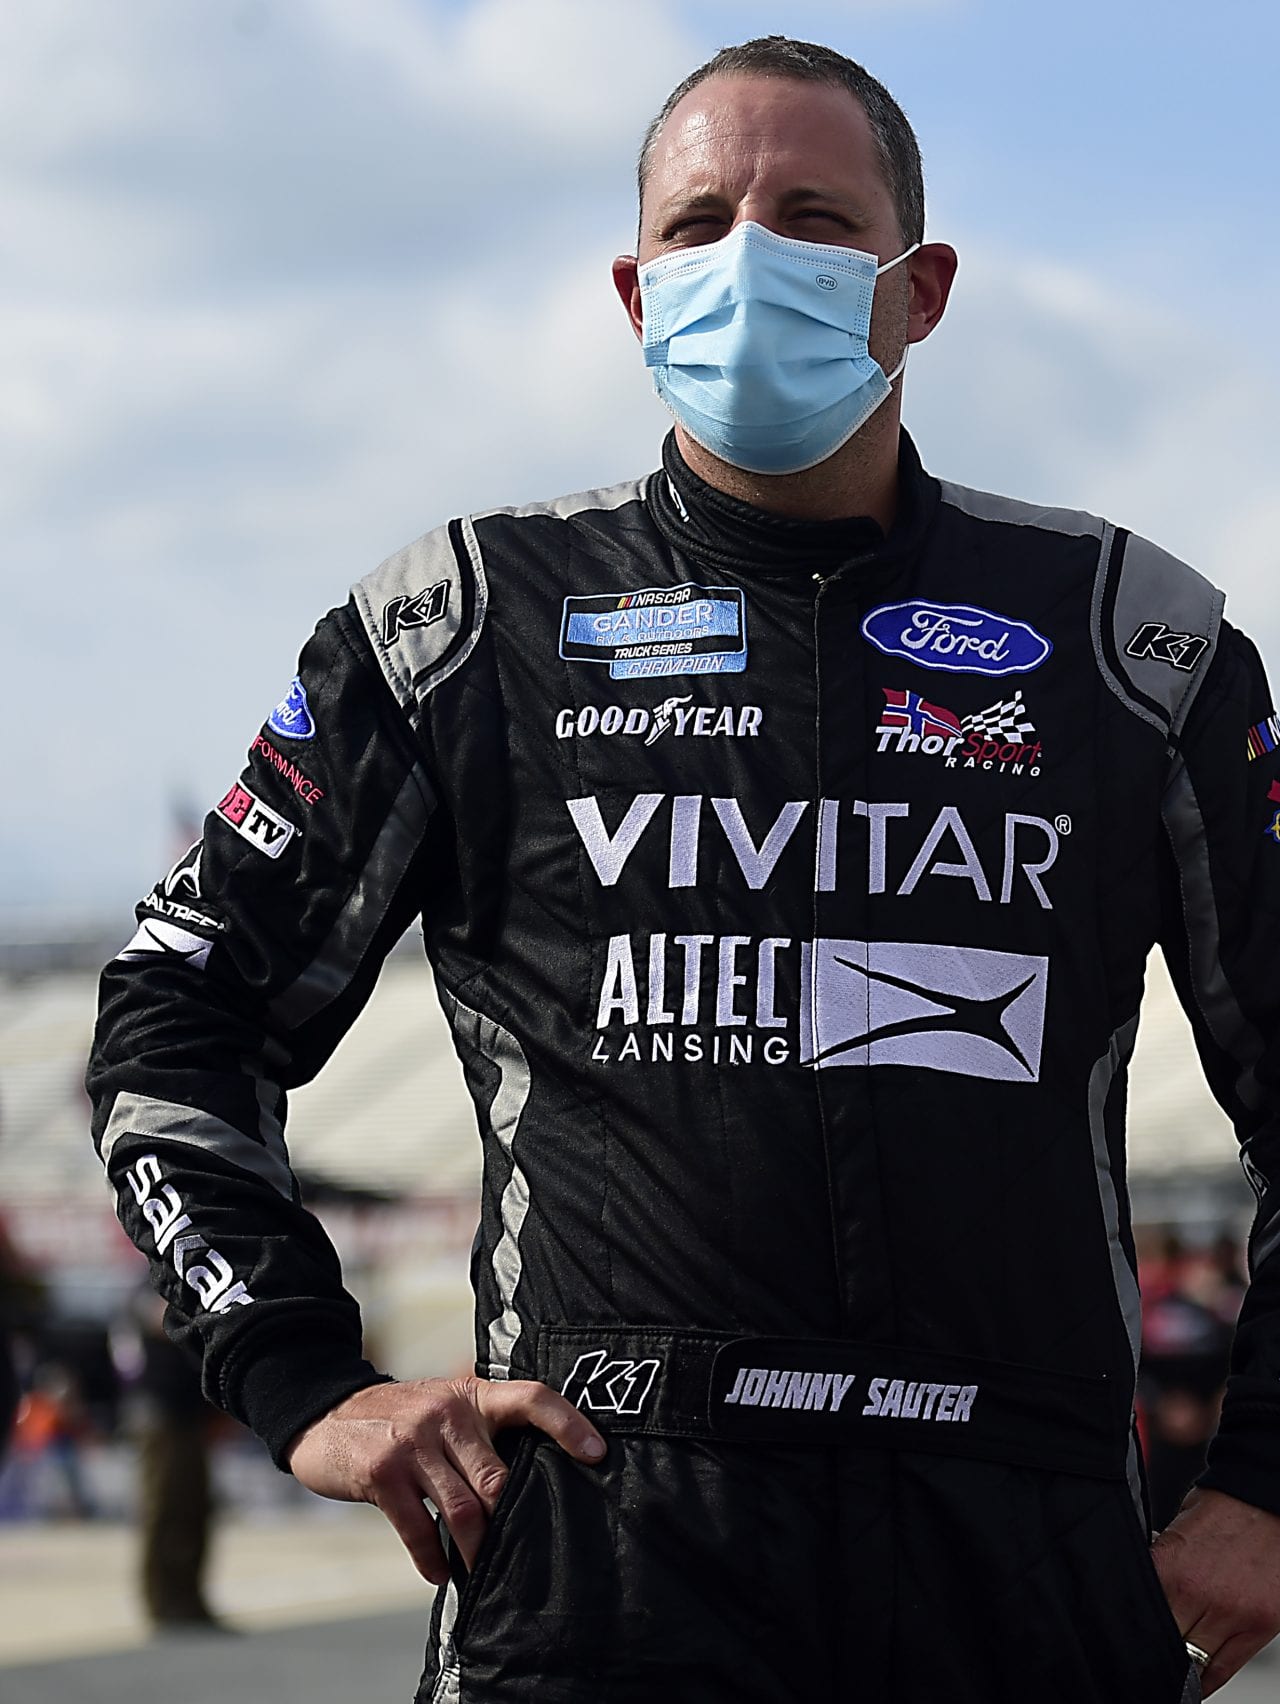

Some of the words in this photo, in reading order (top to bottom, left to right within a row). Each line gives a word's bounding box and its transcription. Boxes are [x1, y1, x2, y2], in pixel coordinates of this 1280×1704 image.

[383, 579, 451, 649] K1
[635, 588, 692, 607] NASCAR
[593, 603, 714, 632] GANDER
[637, 625, 710, 641] OUTDOORS
[901, 610, 1010, 662] Ford
[628, 656, 725, 675] CHAMPION
[1124, 622, 1210, 674] K1
[875, 726, 1042, 765] ThorSport
[944, 756, 1041, 777] RACING
[249, 809, 287, 845] TV
[596, 932, 792, 1029] ALTEC
[591, 1031, 790, 1065] LANSING
[126, 1153, 256, 1314] sakar
[560, 1349, 660, 1414] K1
[725, 1368, 855, 1412] JOHNNY
[862, 1377, 978, 1422] SAUTER
